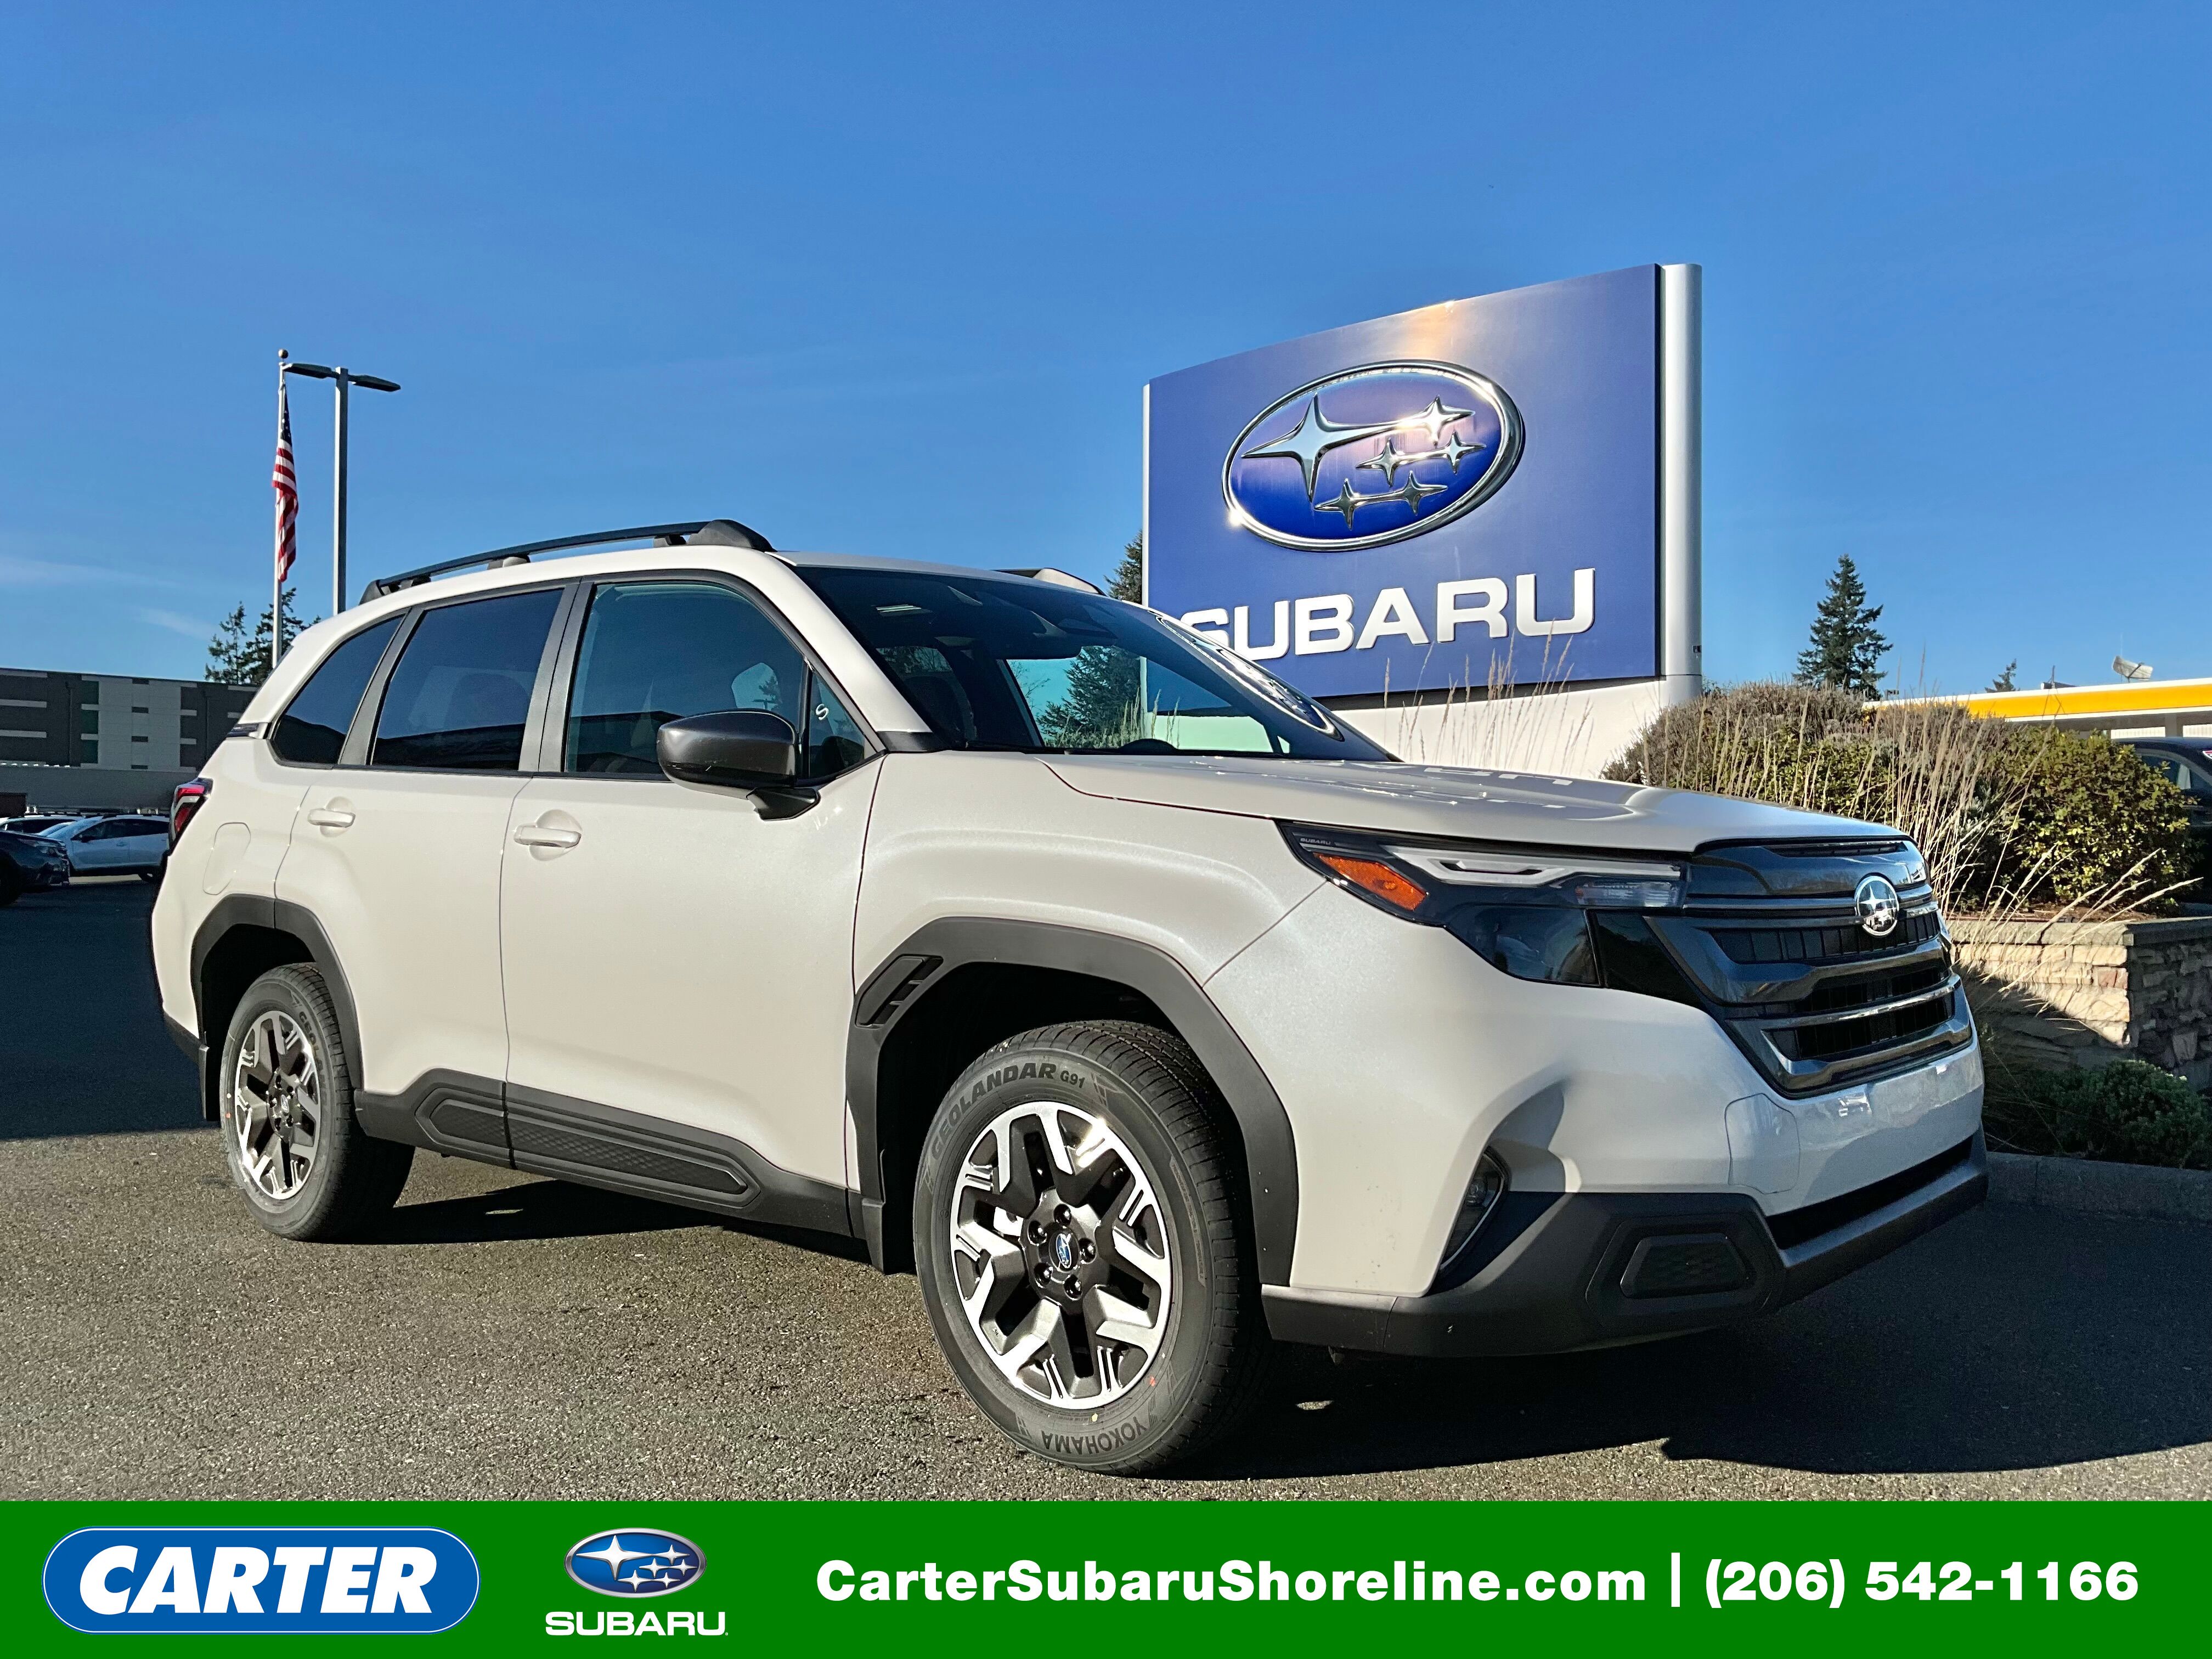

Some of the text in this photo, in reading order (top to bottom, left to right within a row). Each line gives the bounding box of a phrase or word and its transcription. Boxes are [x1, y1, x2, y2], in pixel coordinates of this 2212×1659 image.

[1181, 567, 1595, 661] SUBARU
[932, 1062, 1086, 1160] GEOLANDAR G91
[1041, 1417, 1148, 1454] YOKOHAMA
